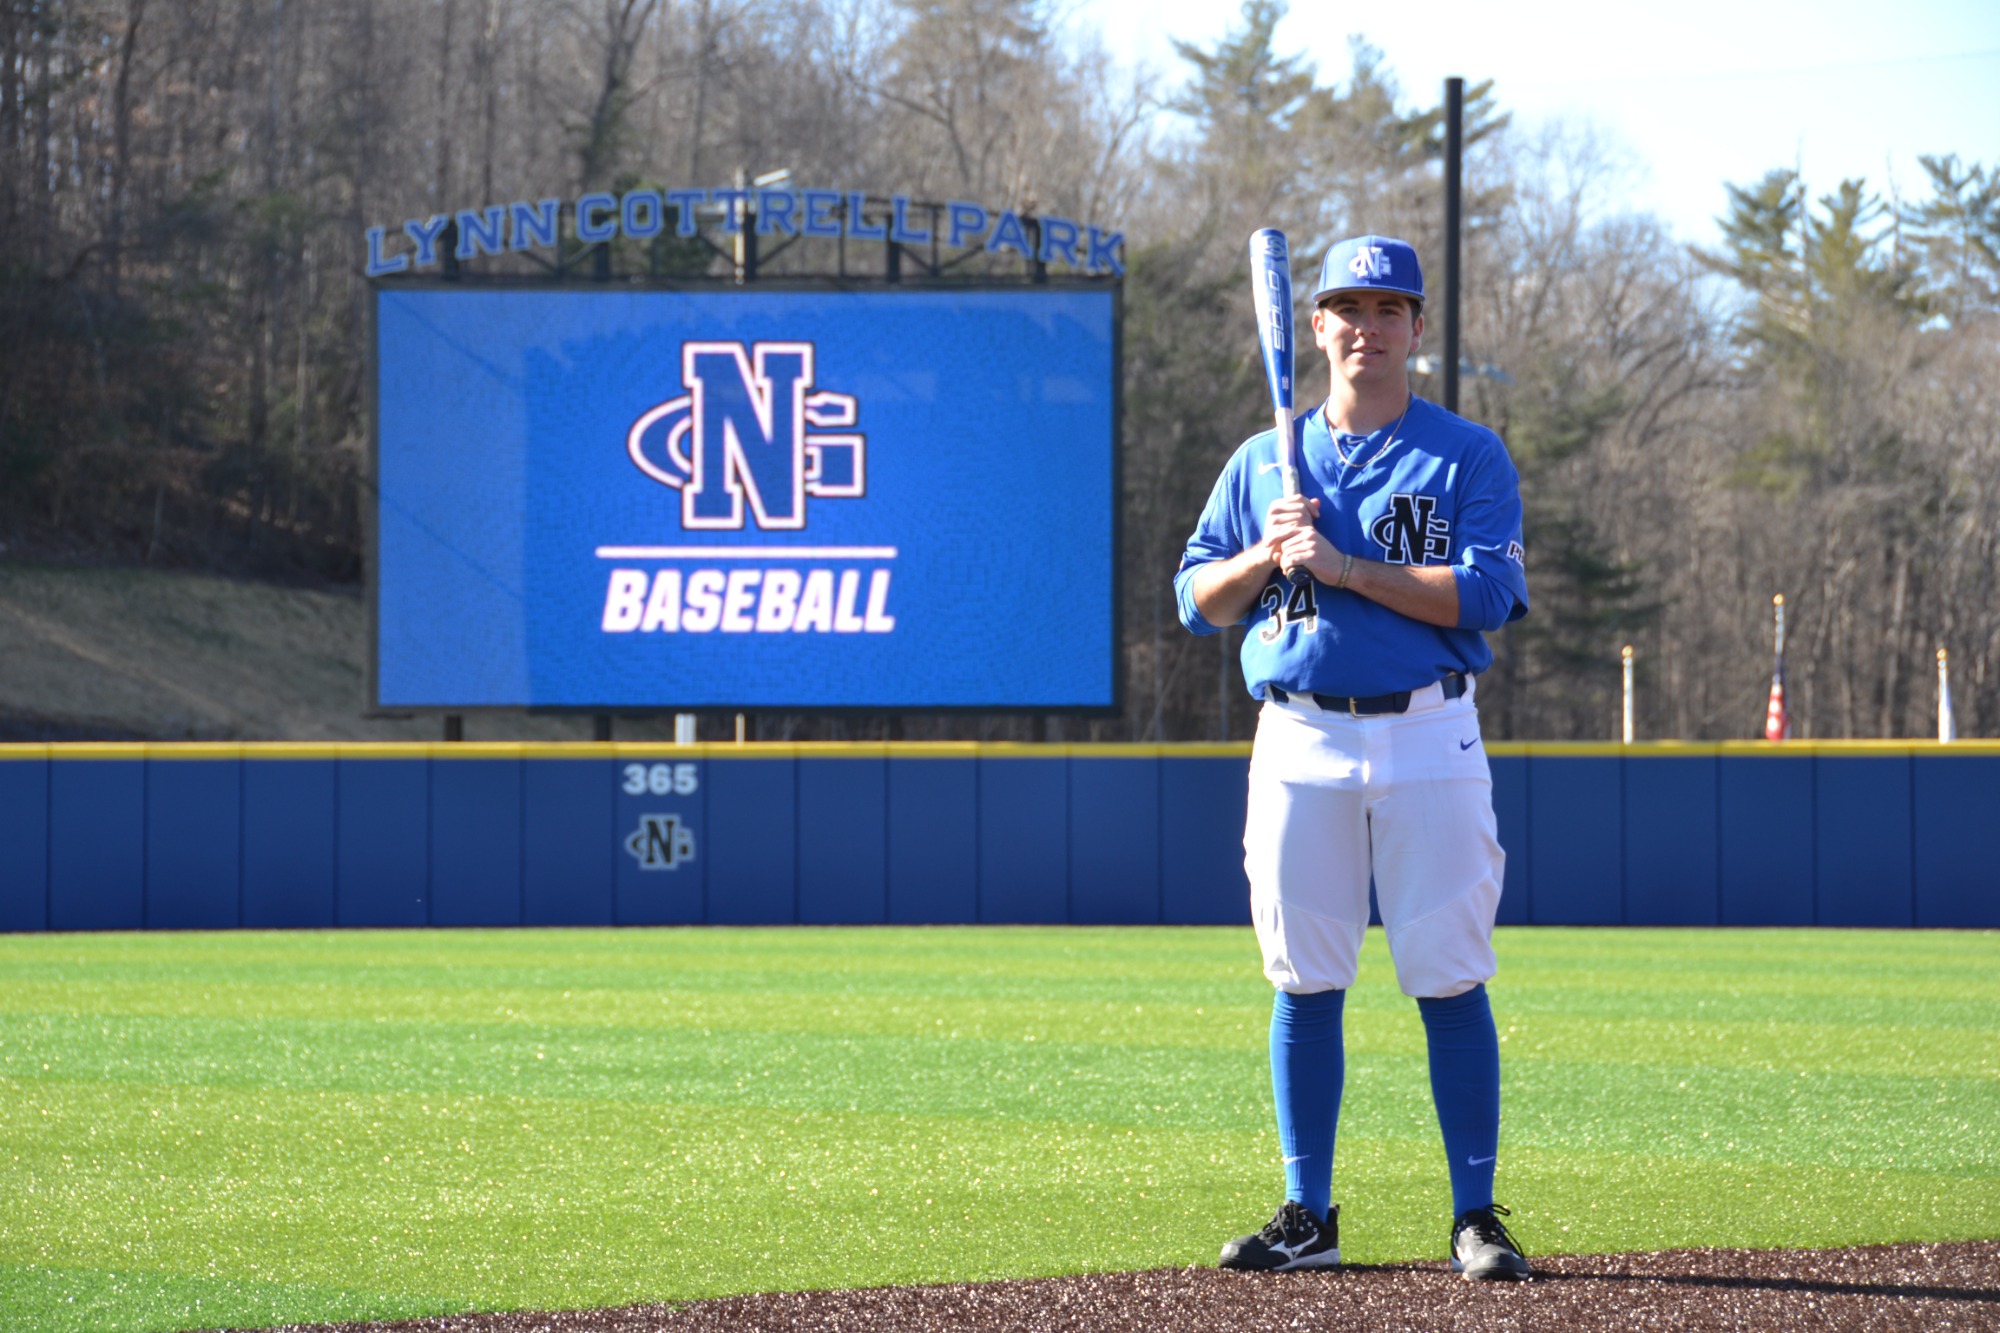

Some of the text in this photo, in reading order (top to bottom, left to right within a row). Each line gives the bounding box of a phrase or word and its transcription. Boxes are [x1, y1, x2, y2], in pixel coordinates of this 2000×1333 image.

[365, 187, 1126, 278] LYNN COTTRELL PARK
[1267, 270, 1285, 352] SOLO
[601, 568, 896, 632] BASEBALL
[1259, 580, 1319, 645] 34
[622, 762, 699, 796] 365
